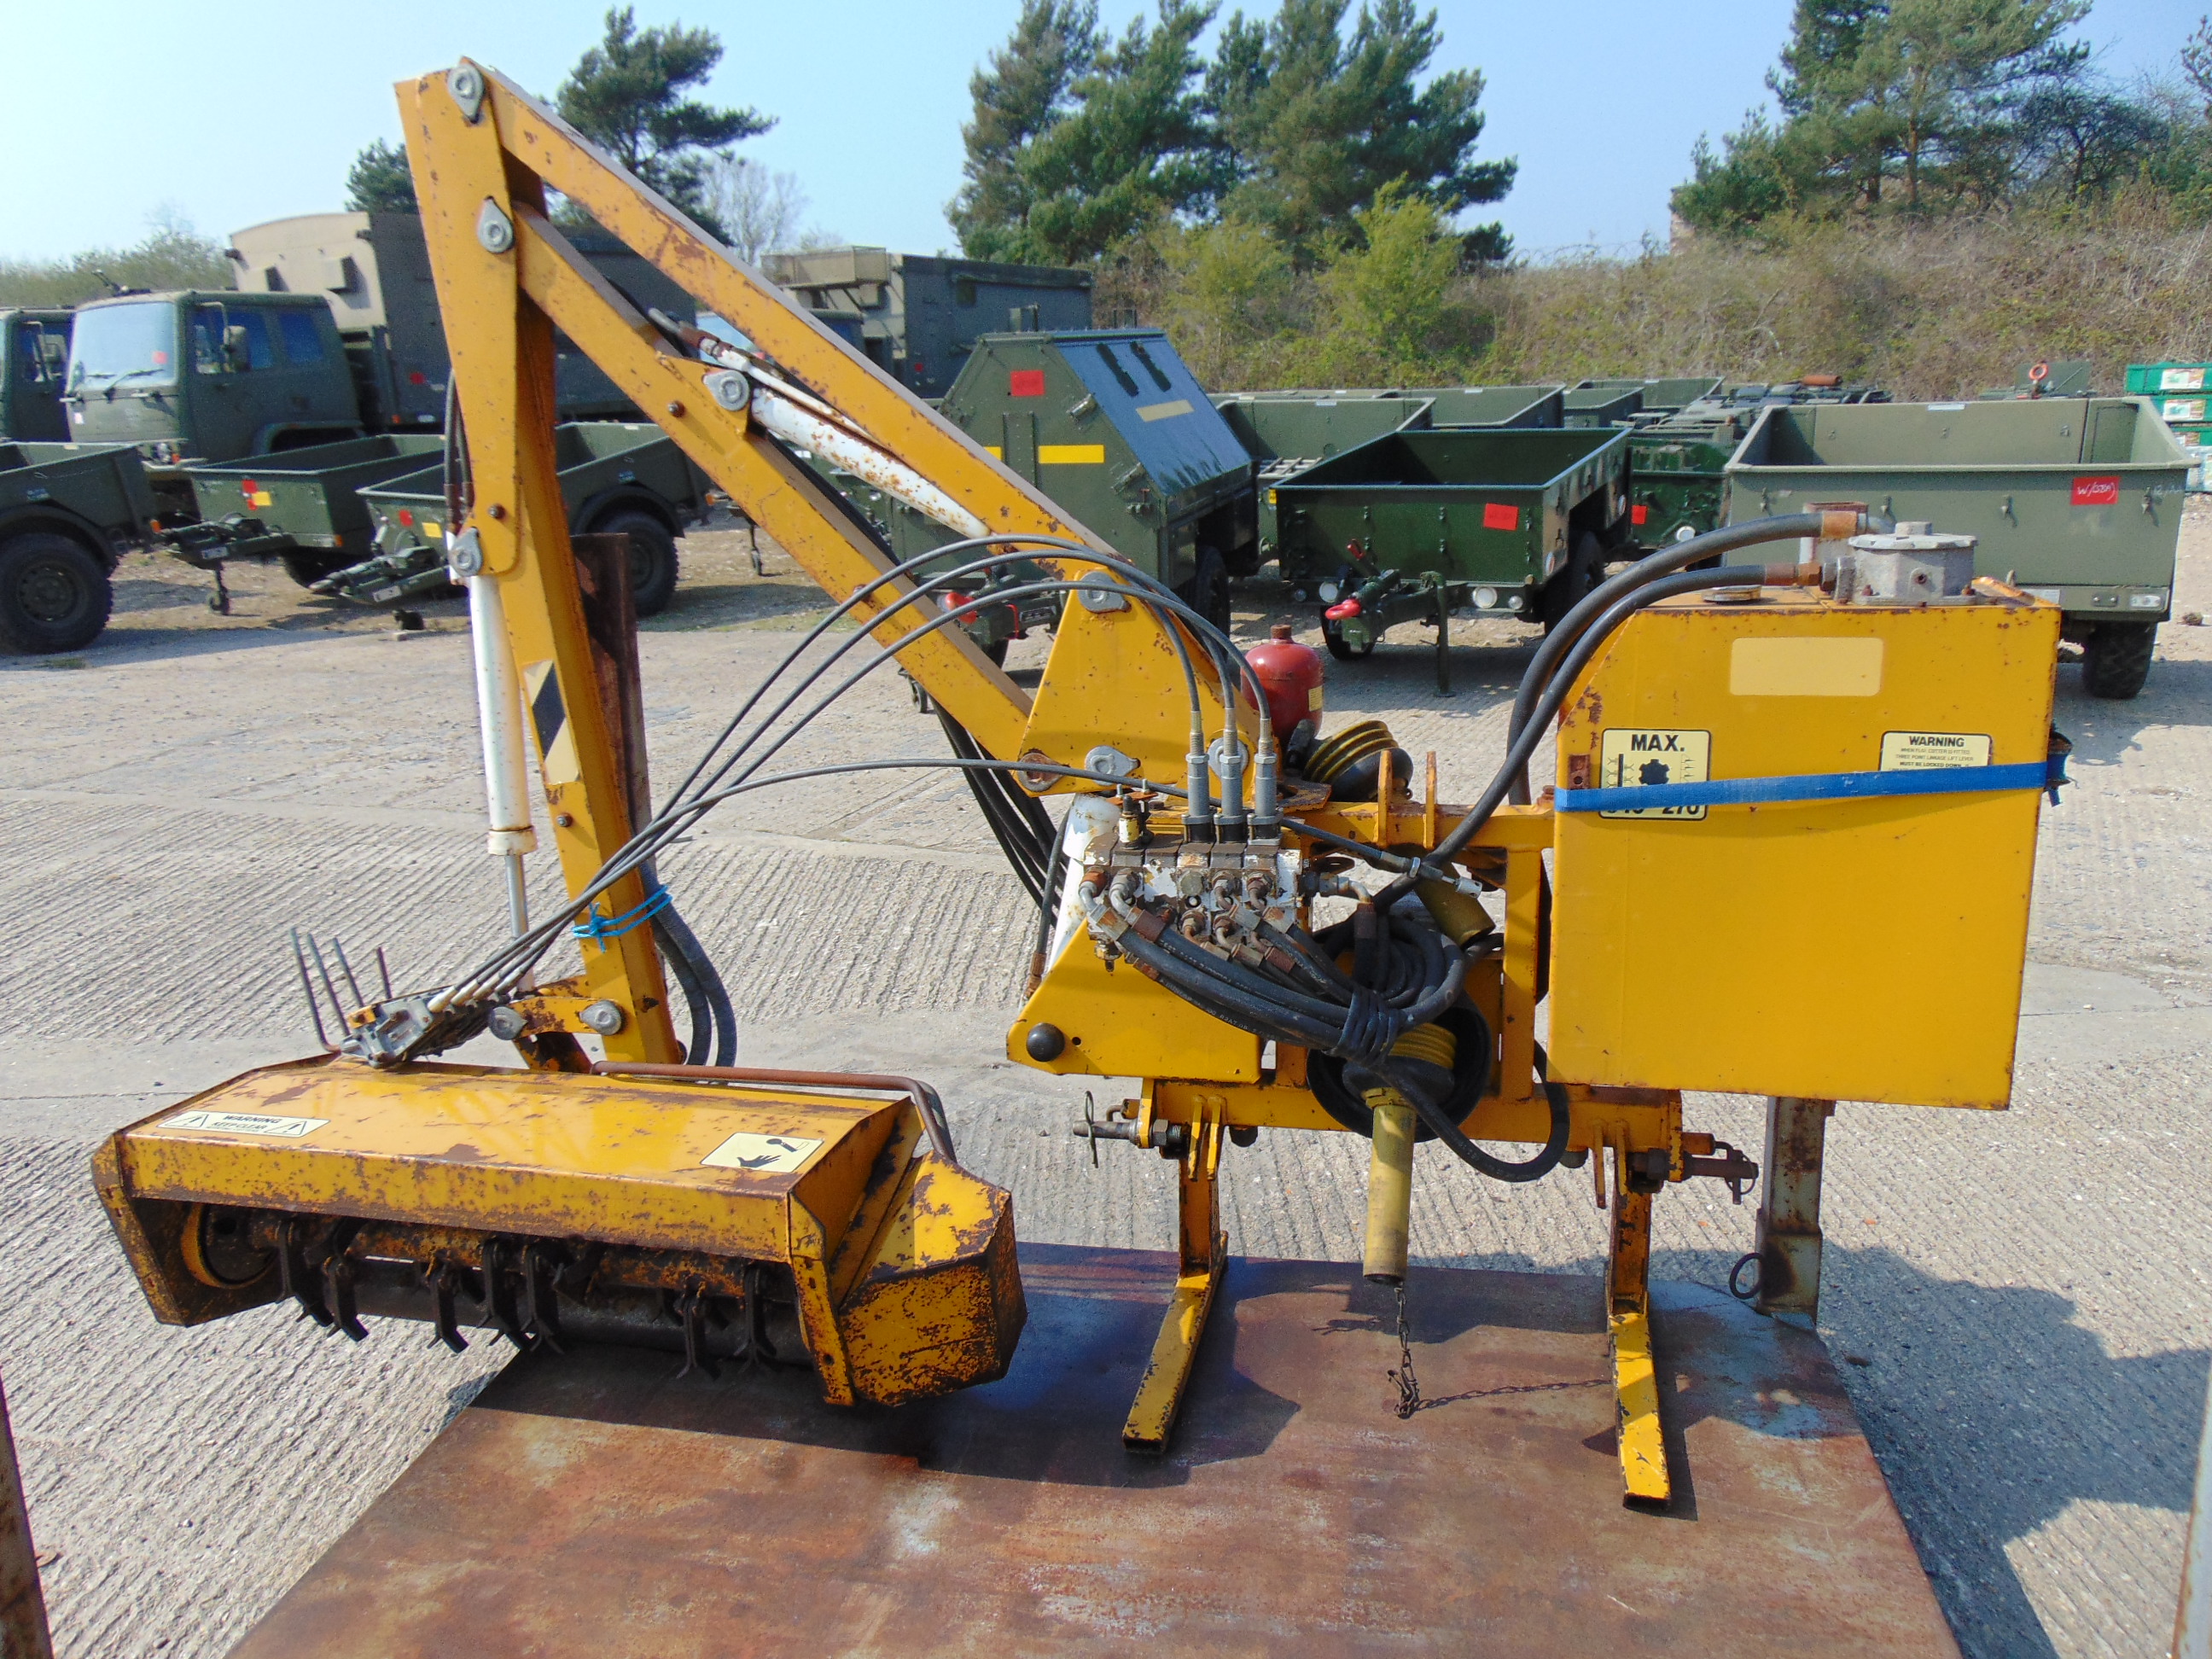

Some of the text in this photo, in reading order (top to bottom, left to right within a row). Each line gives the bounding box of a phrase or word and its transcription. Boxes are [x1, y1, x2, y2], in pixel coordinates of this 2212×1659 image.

[1631, 734, 1685, 752] MAX.
[1908, 736, 1965, 748] WARNING
[223, 1115, 282, 1124] WARNING
